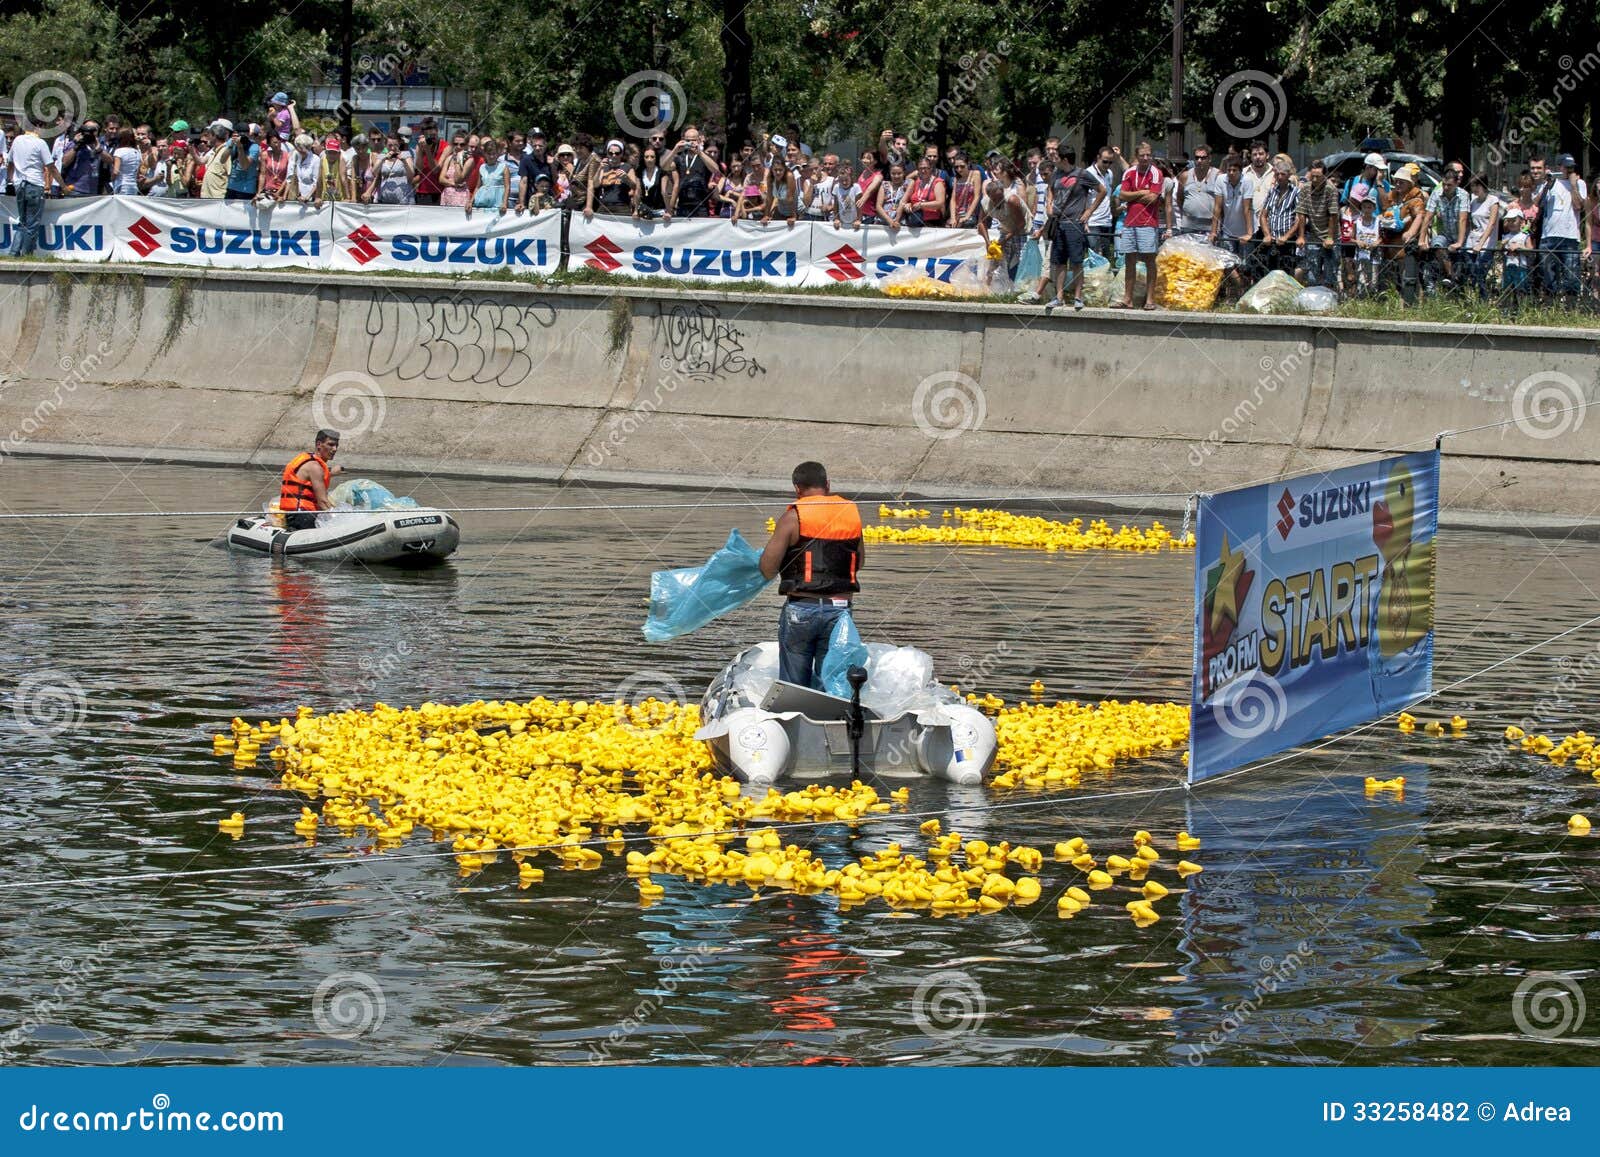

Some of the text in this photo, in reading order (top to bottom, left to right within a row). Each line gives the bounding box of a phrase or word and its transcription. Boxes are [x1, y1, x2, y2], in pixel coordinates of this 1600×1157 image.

[170, 227, 320, 257] SUZUKI
[391, 235, 547, 266] SUZUKI
[632, 245, 797, 277] SUZUKI
[1300, 481, 1370, 528] SUZUKI
[1259, 553, 1380, 676] START
